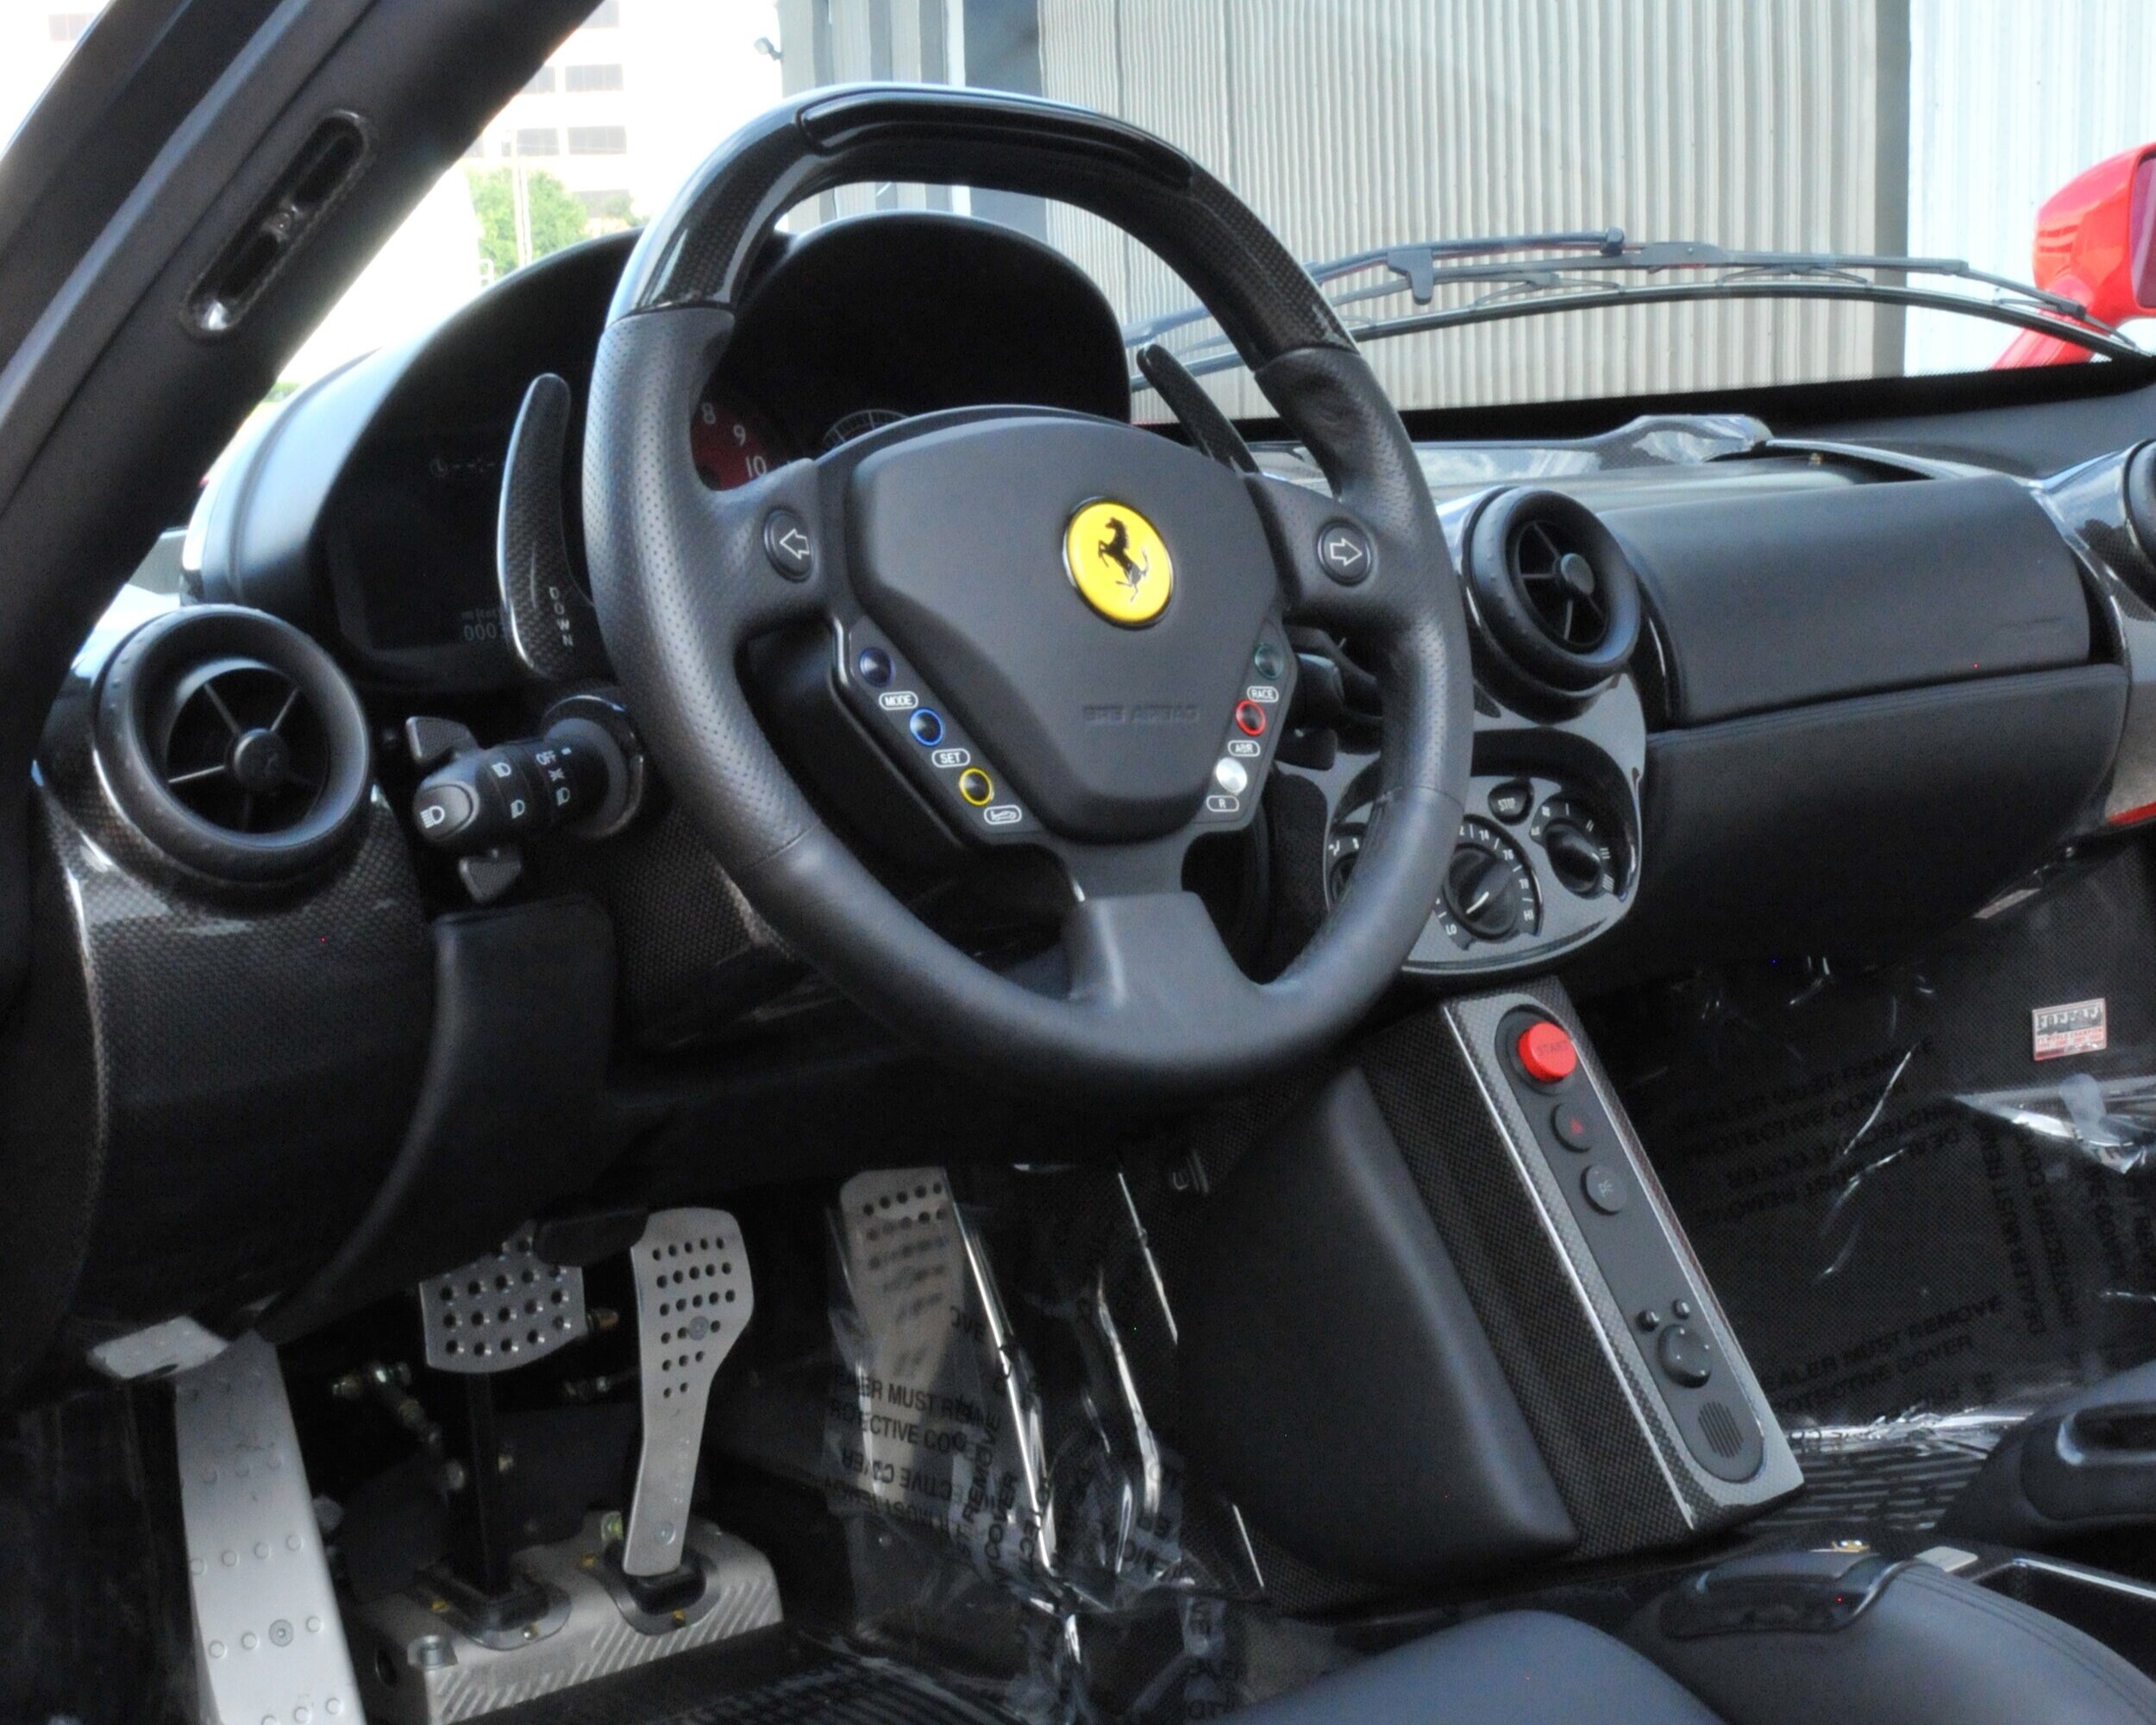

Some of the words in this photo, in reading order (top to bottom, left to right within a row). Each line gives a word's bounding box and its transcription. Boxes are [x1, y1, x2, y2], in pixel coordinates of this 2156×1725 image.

[701, 402, 716, 424] 8
[733, 423, 747, 446] 9
[745, 455, 768, 478] 10
[548, 586, 574, 647] DOWN
[885, 693, 912, 707] MODE
[1251, 689, 1275, 699] RACE
[940, 752, 962, 765] SET
[1219, 798, 1226, 808] R
